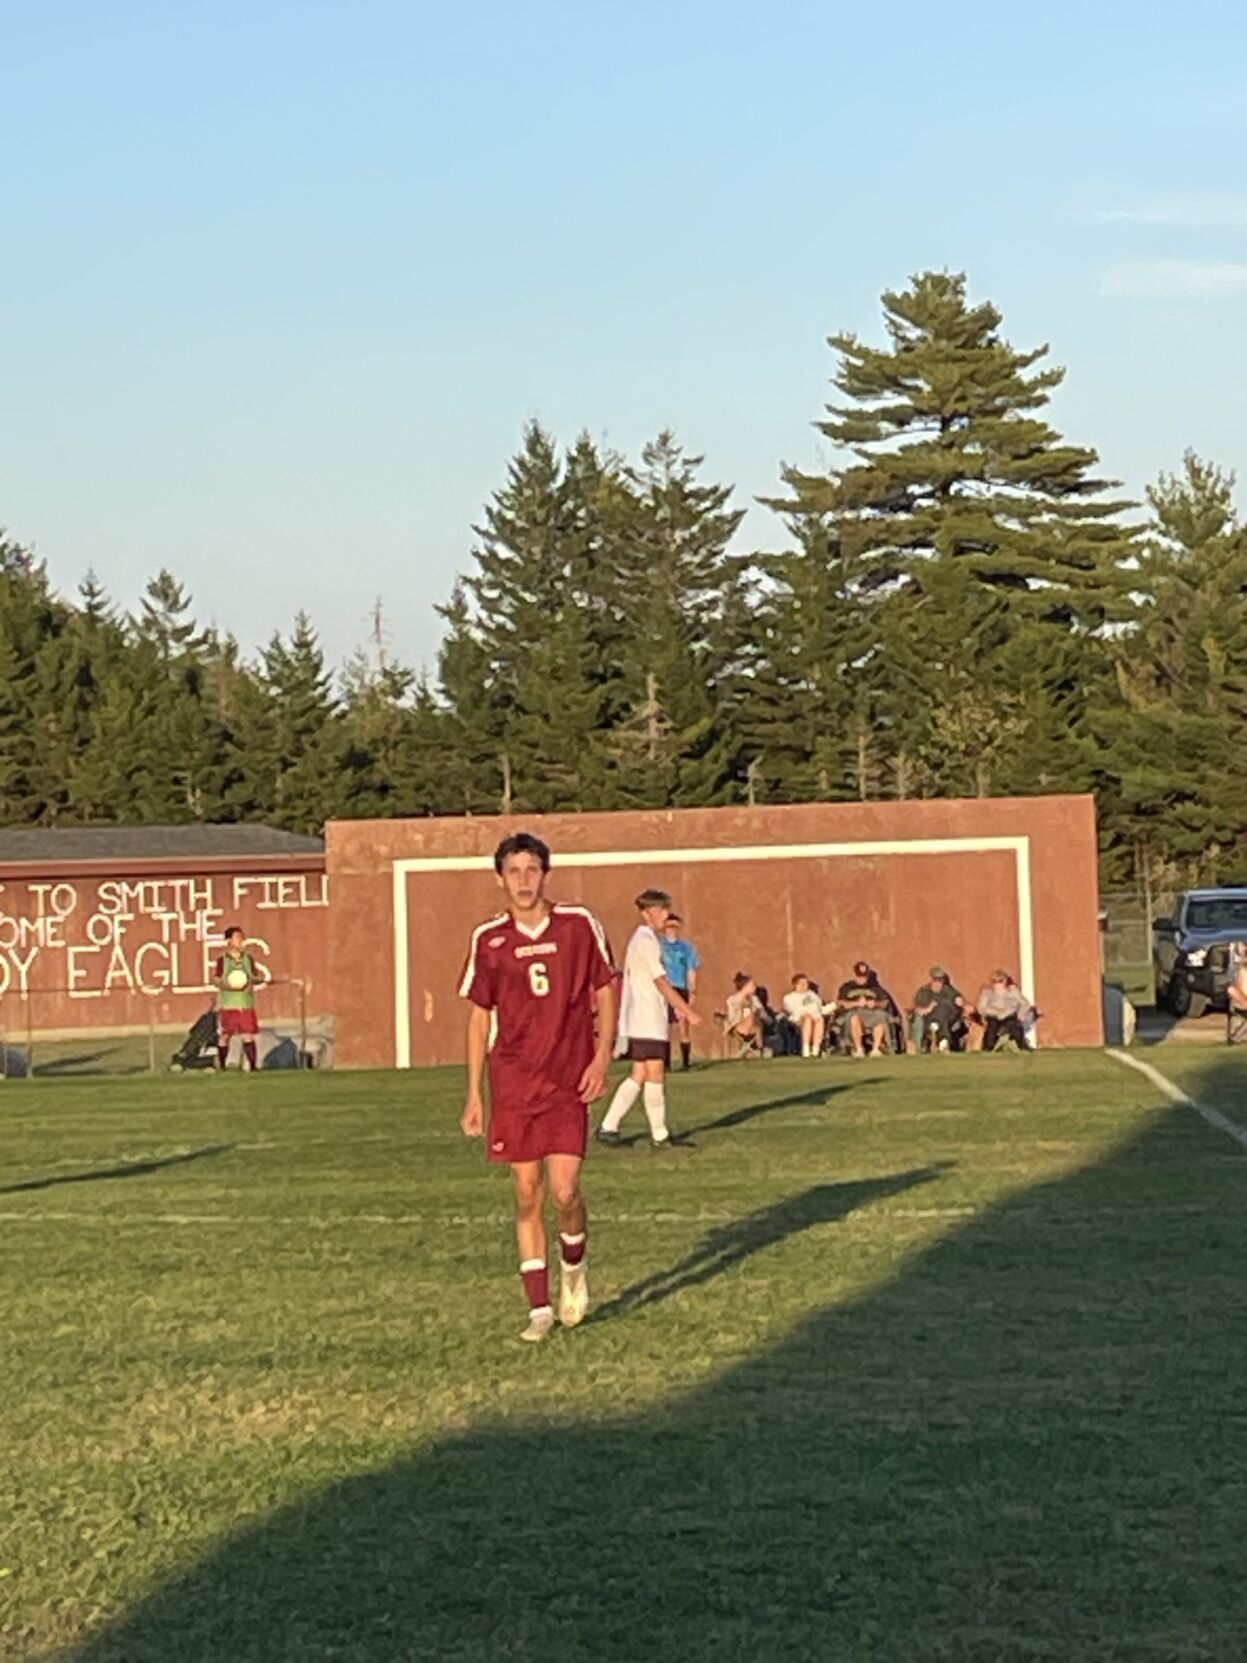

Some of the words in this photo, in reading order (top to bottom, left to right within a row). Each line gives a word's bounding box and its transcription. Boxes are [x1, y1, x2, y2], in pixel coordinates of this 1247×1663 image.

[27, 883, 77, 918] TO
[97, 879, 213, 914] SMITH
[86, 913, 135, 946] OF
[151, 908, 224, 943] THE
[67, 937, 272, 998] EAGLES
[528, 962, 550, 997] 6
